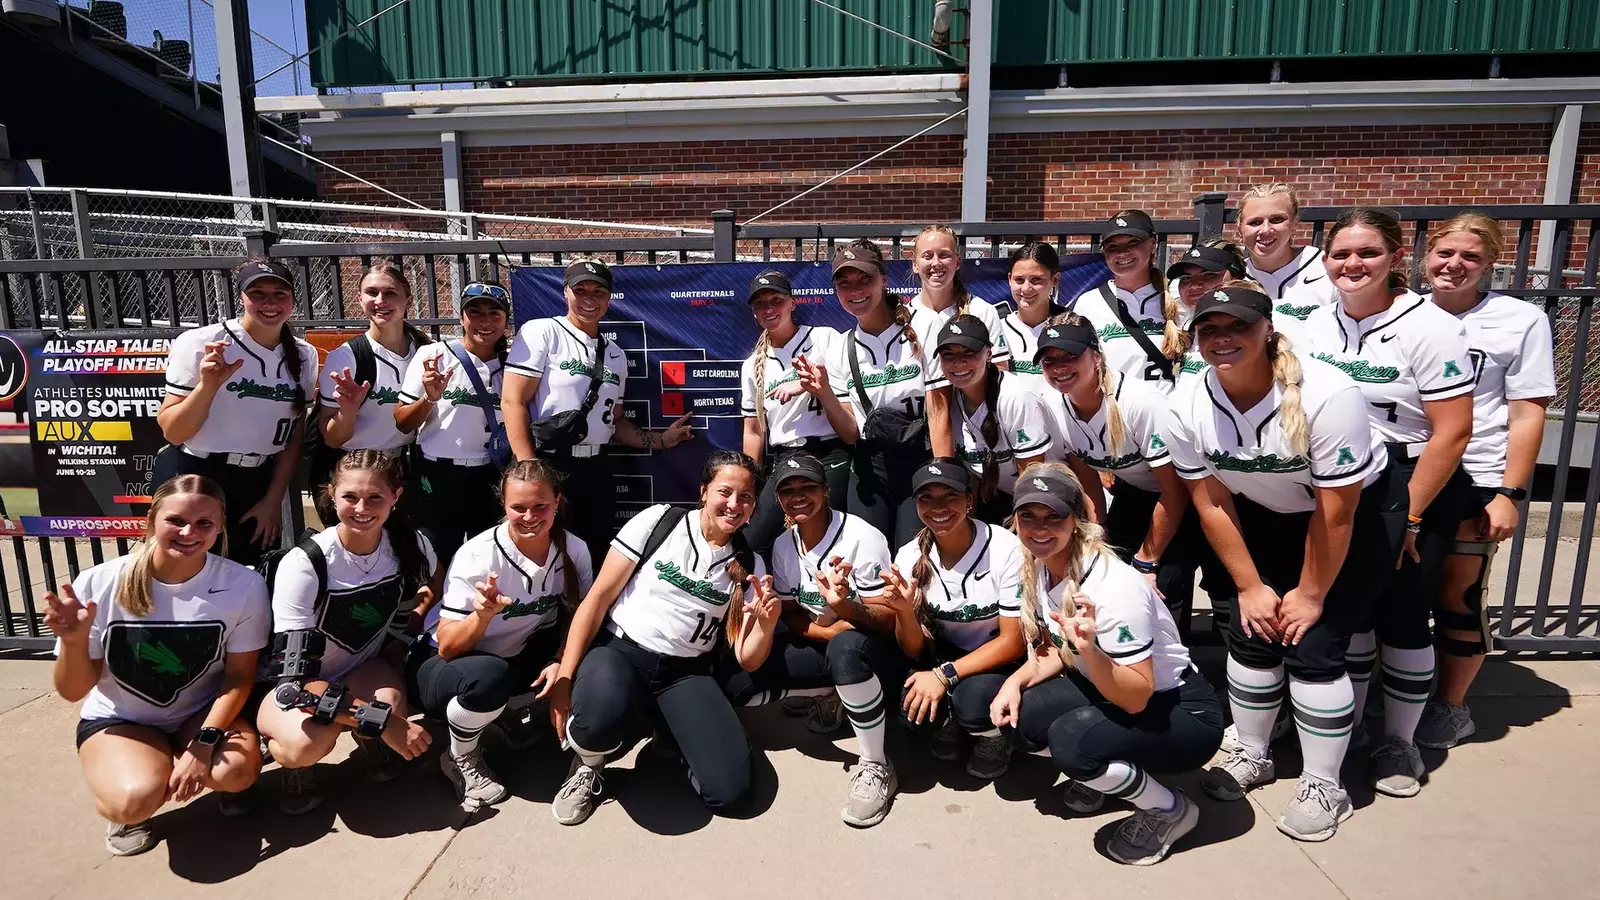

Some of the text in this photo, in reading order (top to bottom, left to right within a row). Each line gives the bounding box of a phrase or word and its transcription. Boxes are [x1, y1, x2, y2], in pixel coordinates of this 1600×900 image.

[670, 290, 735, 299] QUARTERFINALS
[43, 340, 117, 353] ALL-STAR
[43, 359, 114, 372] PLAYOFF
[692, 369, 740, 378] EAST CAROLINA
[1350, 360, 1400, 383] Green
[880, 364, 921, 386] Green
[34, 388, 102, 398] ATHLETES
[693, 397, 735, 407] NORTH TEXAS
[35, 400, 83, 418] PRO
[44, 421, 95, 441] AUX
[61, 446, 117, 456] WICHITA!
[1336, 446, 1356, 466] A
[654, 560, 698, 597] Mean
[689, 612, 720, 646] 14
[1117, 625, 1136, 643] A
